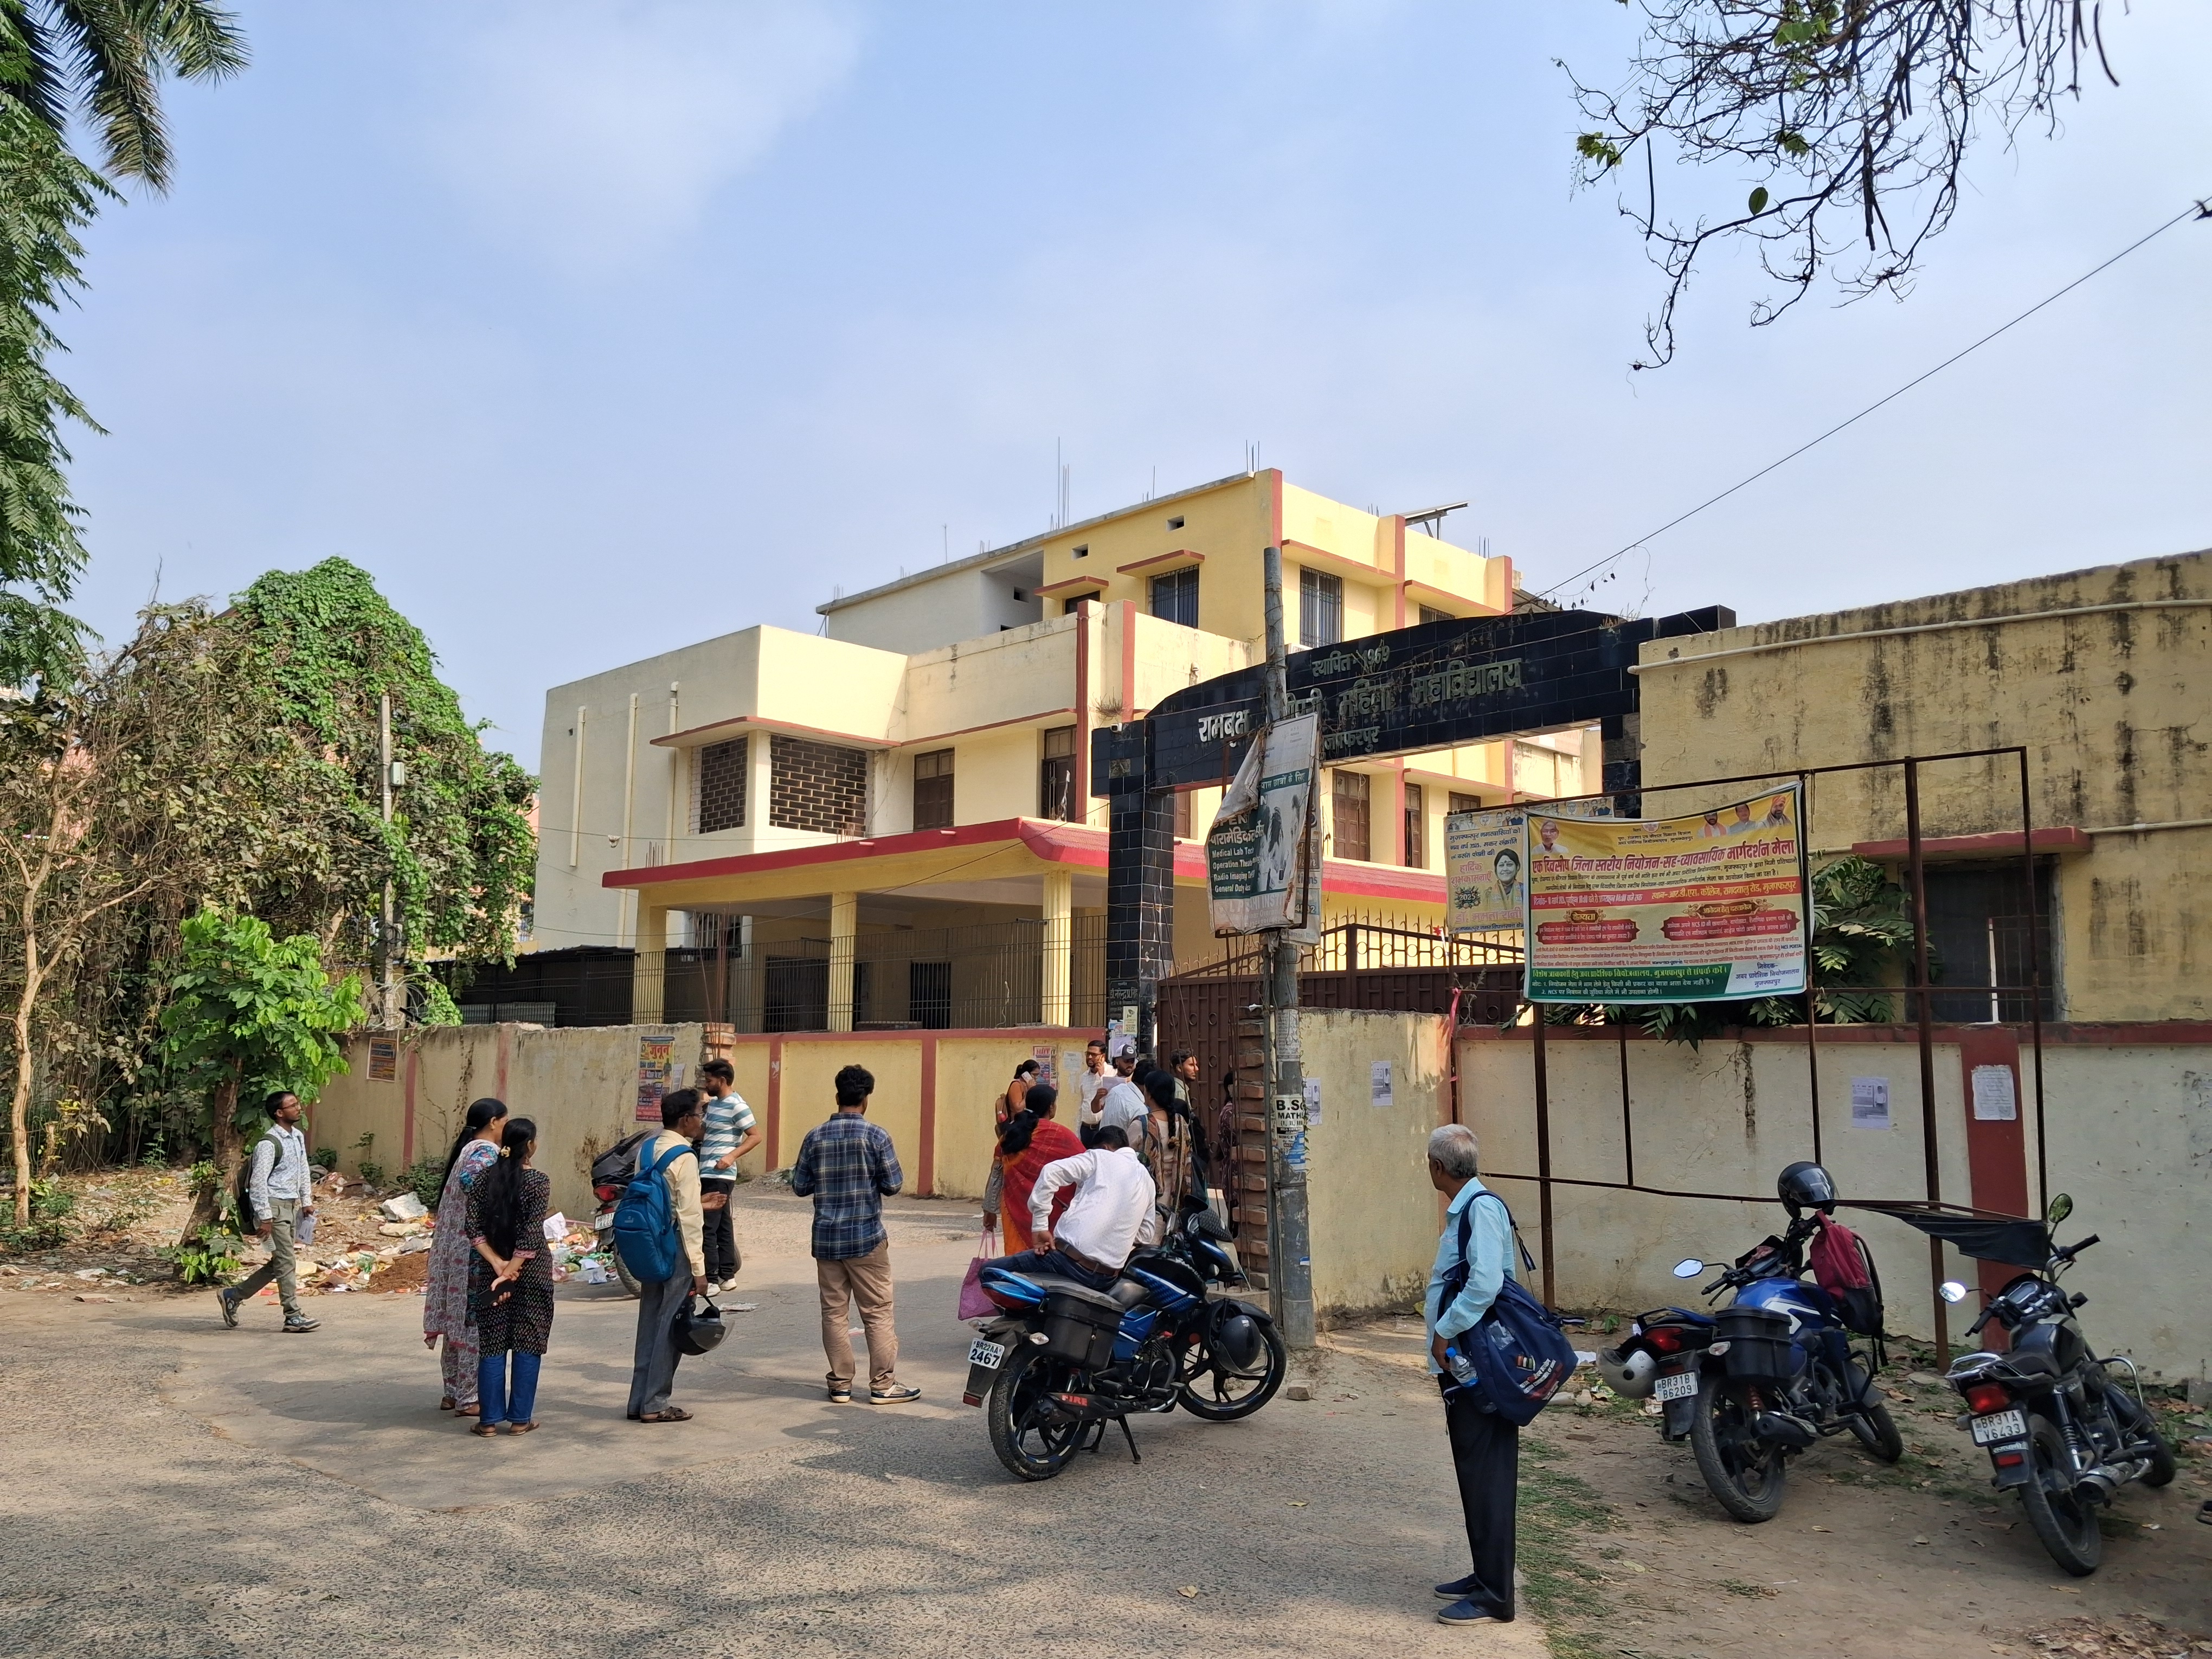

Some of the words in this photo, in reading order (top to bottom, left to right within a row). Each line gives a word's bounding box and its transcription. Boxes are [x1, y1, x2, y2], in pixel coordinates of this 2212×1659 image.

[1312, 651, 1352, 677] स्थापित
[1363, 645, 1390, 667] 1969
[1339, 679, 1392, 717] महिला
[1412, 658, 1522, 704] महाविद्यालय
[1450, 833, 1479, 843] मुजफ्फरपुर
[1480, 827, 1511, 837] नगरवासियों
[1212, 848, 1232, 858] Medical
[1532, 860, 1544, 873] एक
[1544, 855, 1570, 873] दिवसीय
[1571, 855, 1594, 871] जिला
[1596, 855, 1623, 872] स्तरीय
[1624, 846, 1726, 870] नियोजन-सह-व्यावसायिक
[1727, 839, 1770, 860] मार्गदर्शन
[1771, 837, 1795, 855] मेला
[1213, 861, 1238, 871] Operation
[1459, 860, 1482, 873] हार्दिक
[1724, 864, 1747, 872] मुजफ्फरपुर
[1214, 873, 1229, 882] Radio
[1230, 872, 1247, 881] Imaging
[1214, 884, 1233, 893] General
[1235, 884, 1244, 893] Duty
[1700, 886, 1722, 897] कॉलेज,
[1763, 881, 1796, 894] मुजफ्फरपुर
[1472, 911, 1499, 922] ममता
[1501, 906, 1523, 920] रानी
[1533, 969, 1547, 978] विशेष
[1548, 969, 1570, 978] जानकारी
[1591, 969, 1612, 978] प्रादेशिक
[1687, 967, 1692, 975] से
[1694, 966, 1711, 975] संपर्क
[1754, 979, 1781, 988] मुजफ्फरपुर
[1590, 988, 1603, 996] सुविधा
[976, 1341, 998, 1354] BR22AA
[970, 1348, 1000, 1366] 2467
[1661, 1374, 1690, 1389] BR31B
[1663, 1385, 1692, 1399] B6209
[1062, 1395, 1088, 1406] FIRE
[1980, 1411, 2018, 1428] BR31A
[1984, 1423, 2021, 1440] V6433
